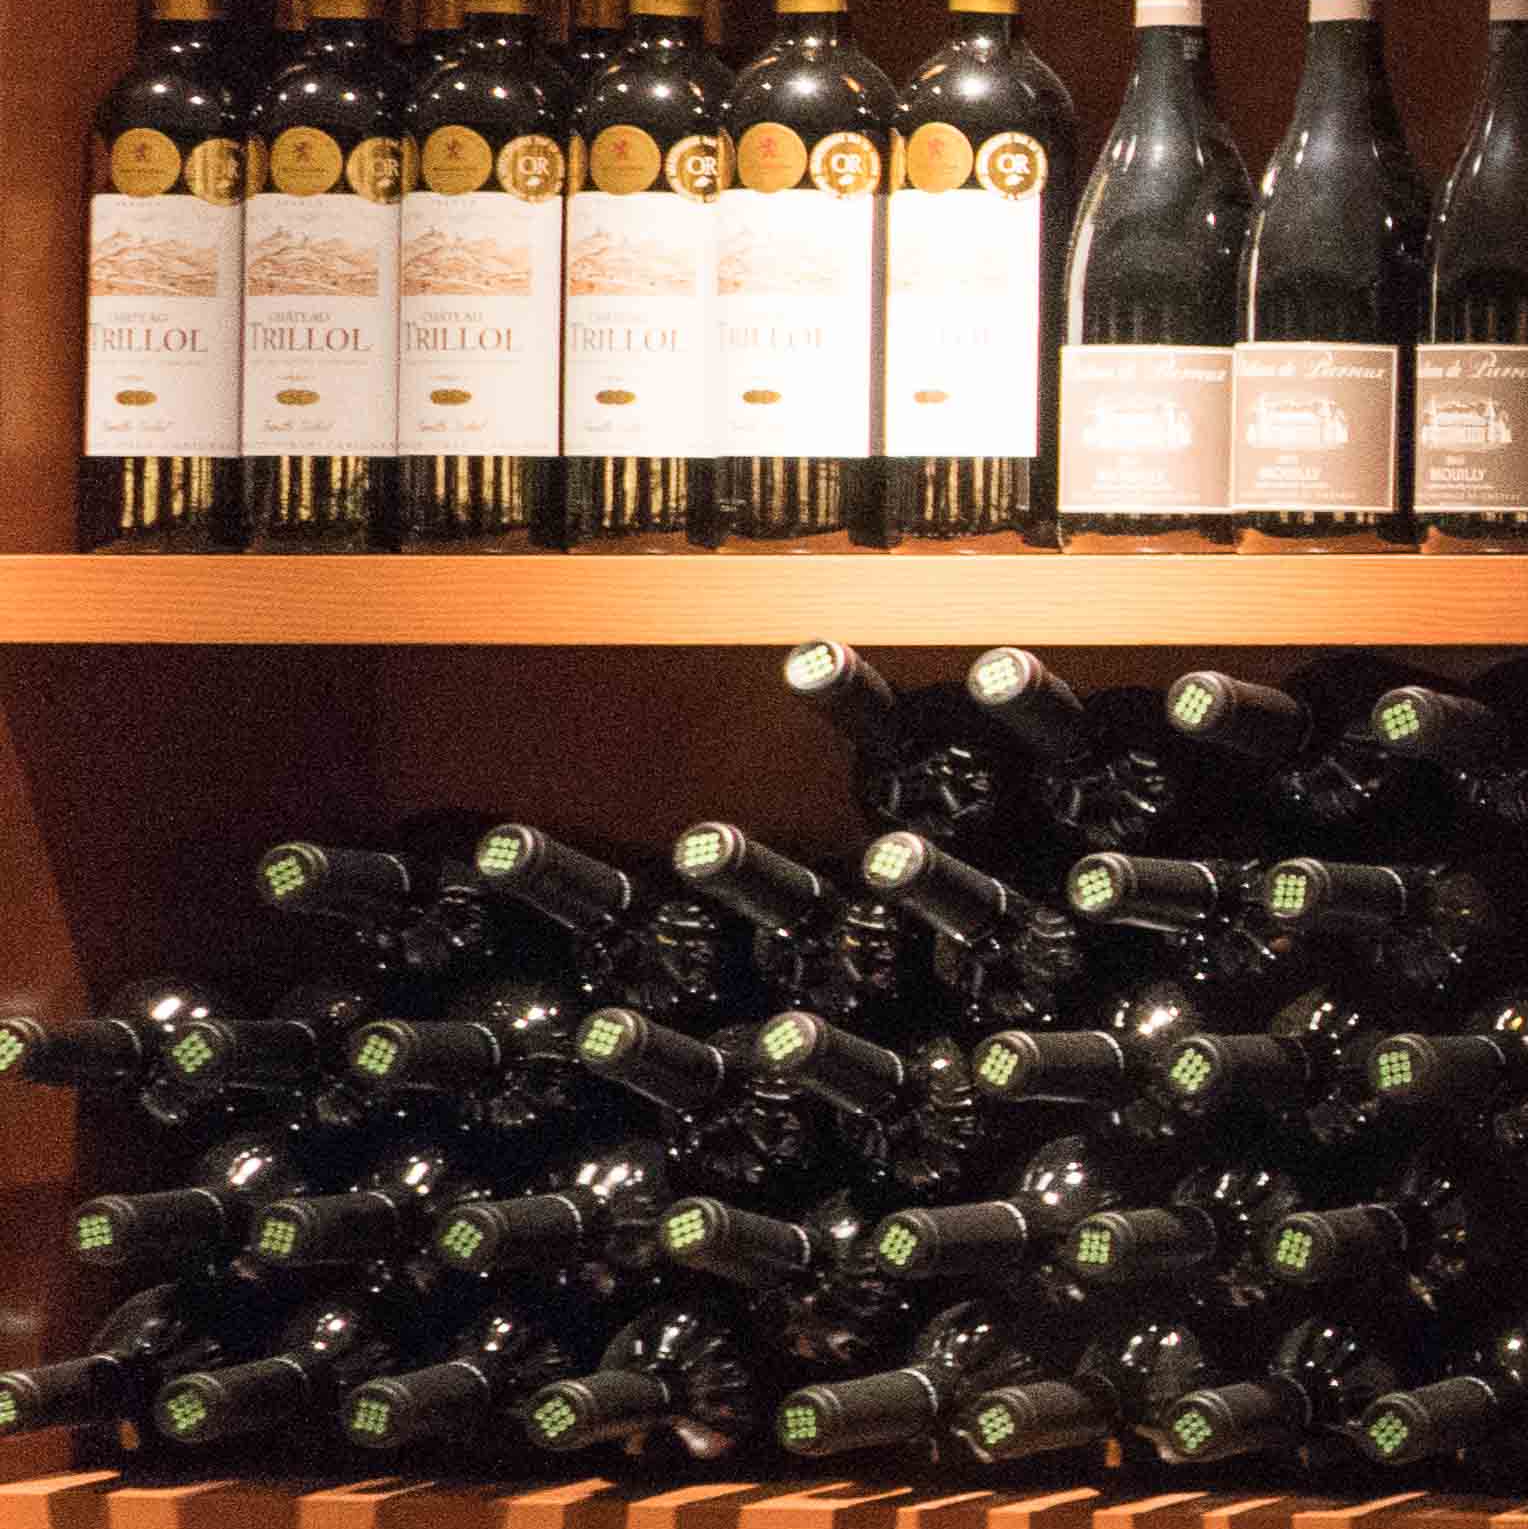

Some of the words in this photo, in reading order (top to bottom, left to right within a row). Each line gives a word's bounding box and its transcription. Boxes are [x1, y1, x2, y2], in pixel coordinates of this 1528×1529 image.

[829, 153, 864, 175] OR
[996, 153, 1030, 175] OR
[249, 322, 374, 353] TRILLOL
[402, 322, 523, 353] TRILLOL
